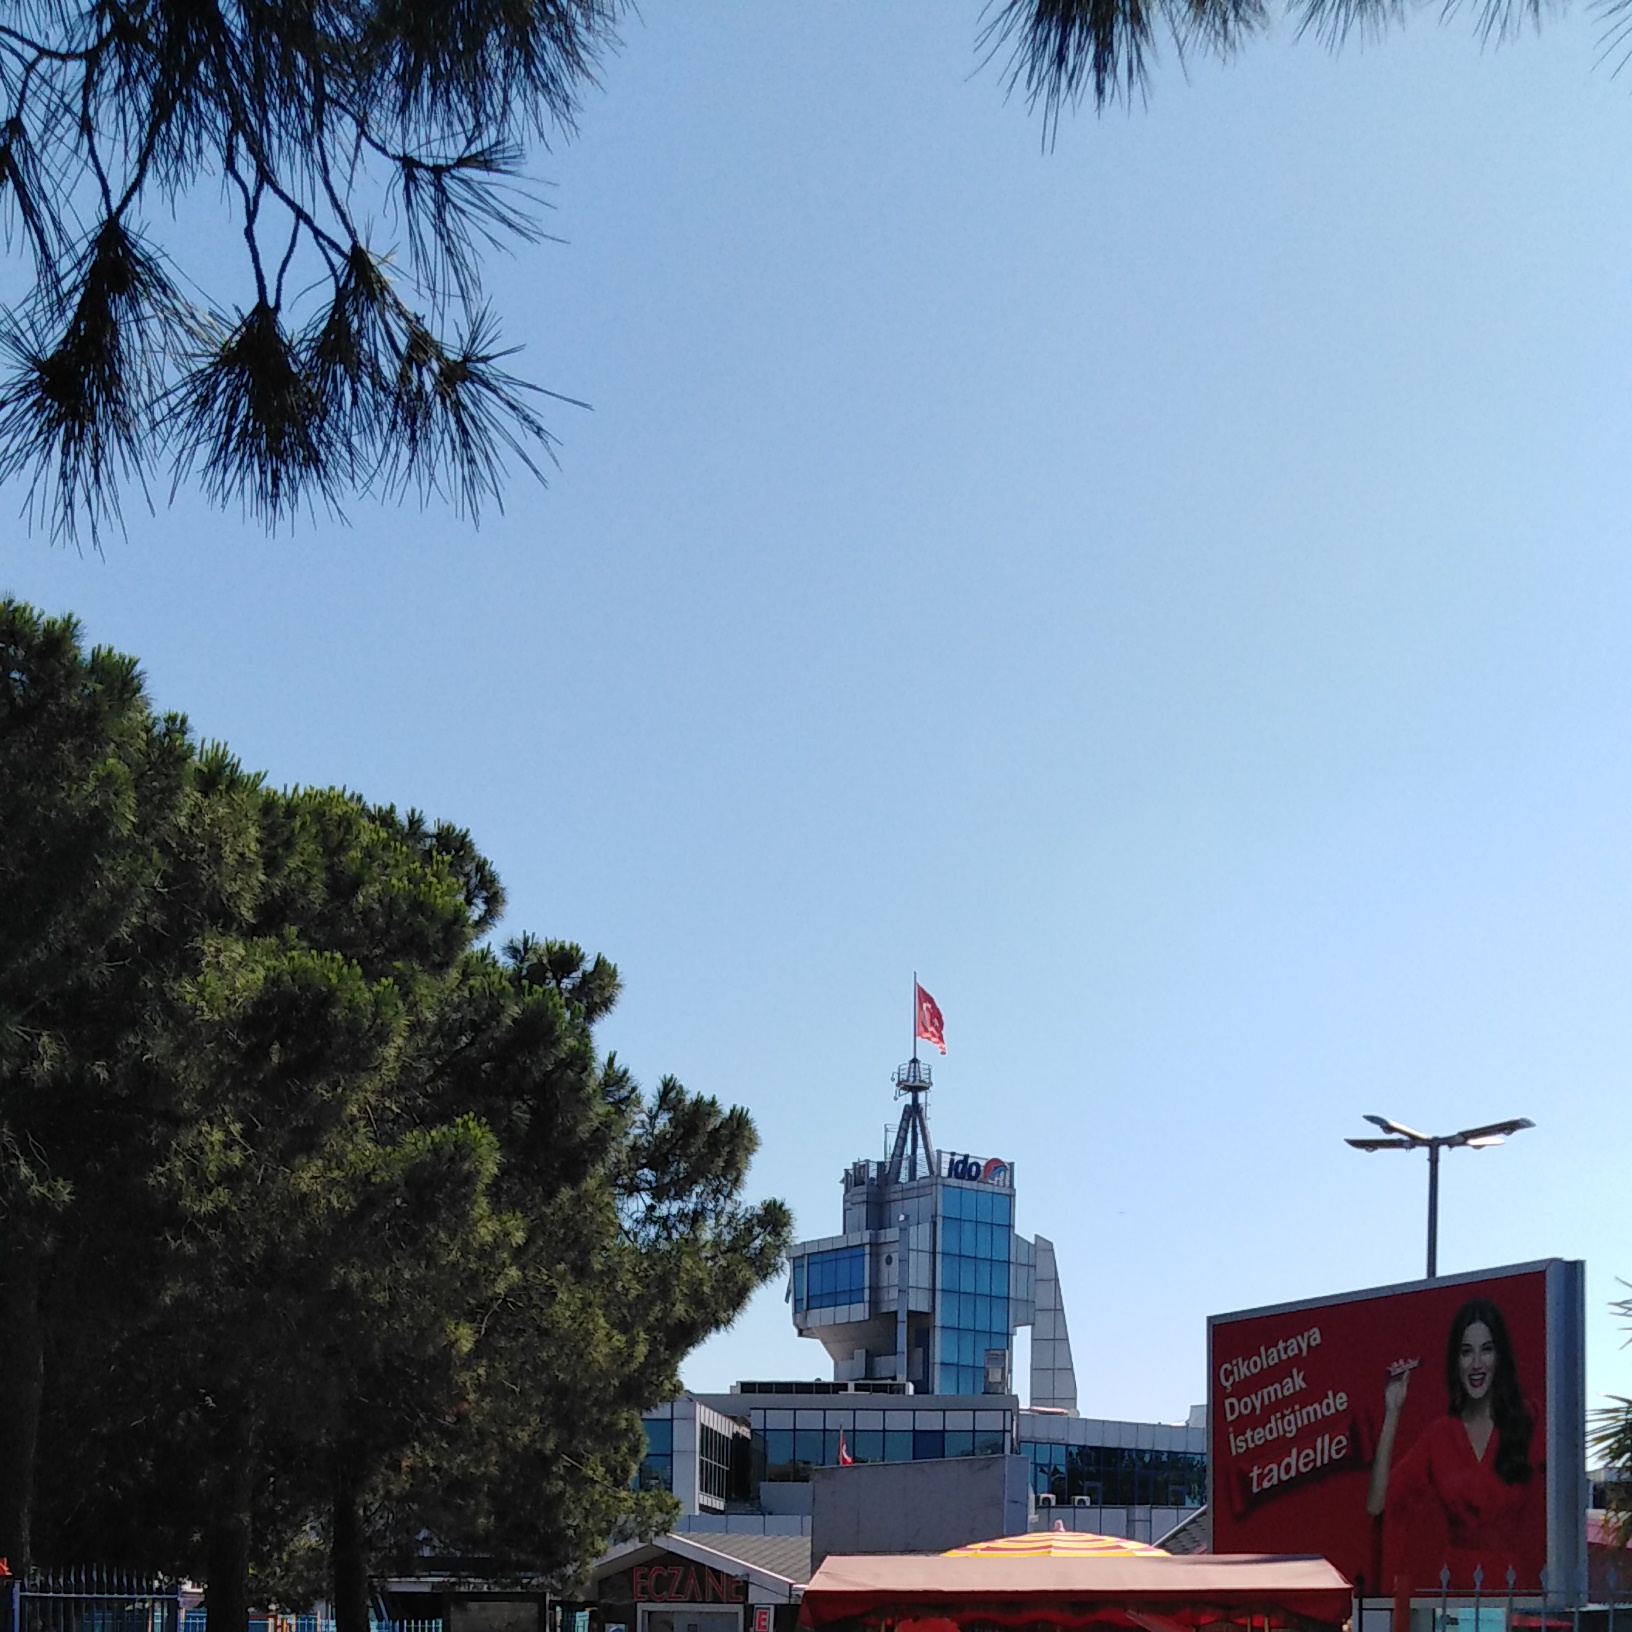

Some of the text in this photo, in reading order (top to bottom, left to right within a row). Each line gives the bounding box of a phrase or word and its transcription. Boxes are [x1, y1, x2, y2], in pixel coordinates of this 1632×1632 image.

[948, 1151, 981, 1181] ido
[1219, 1327, 1322, 1393] Çikolataya
[1224, 1367, 1307, 1422] Doymak
[1228, 1390, 1348, 1456] İstediğimde
[1249, 1434, 1347, 1493] tadelle
[633, 1566, 743, 1602] ECZANE
